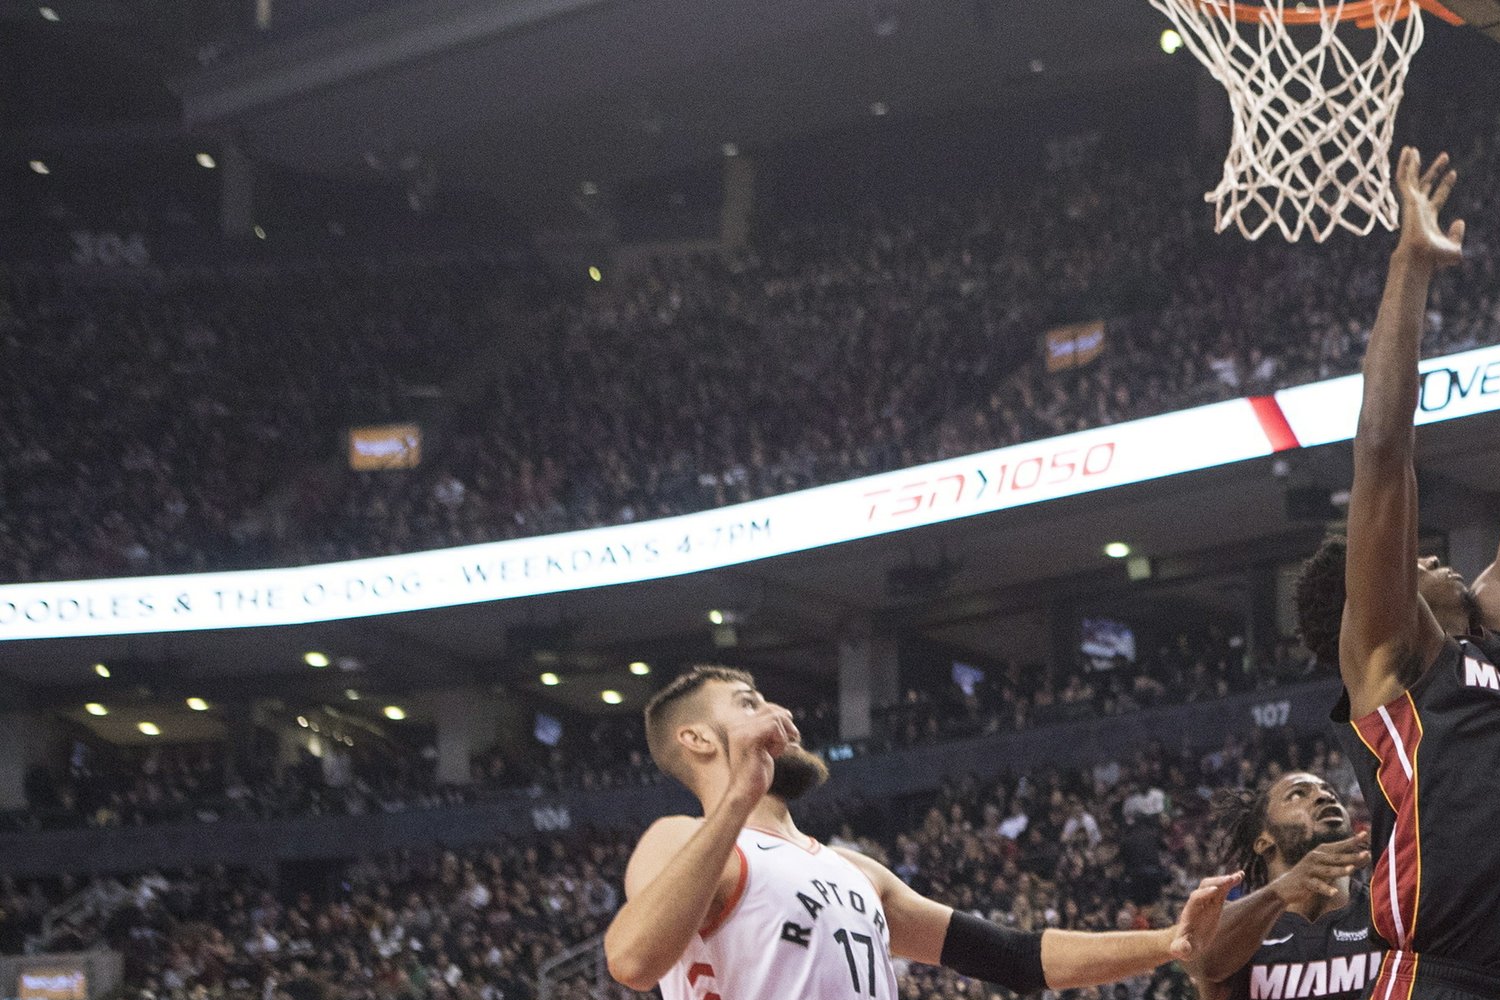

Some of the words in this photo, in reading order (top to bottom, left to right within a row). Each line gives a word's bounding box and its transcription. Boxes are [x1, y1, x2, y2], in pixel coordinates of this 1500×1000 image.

[213, 587, 286, 611] THE
[461, 541, 660, 584] WEEKDAYS
[1250, 701, 1290, 728] 107
[781, 879, 888, 950] RAPTOR
[833, 927, 877, 999] 17
[1250, 951, 1382, 1000] MIAMI
